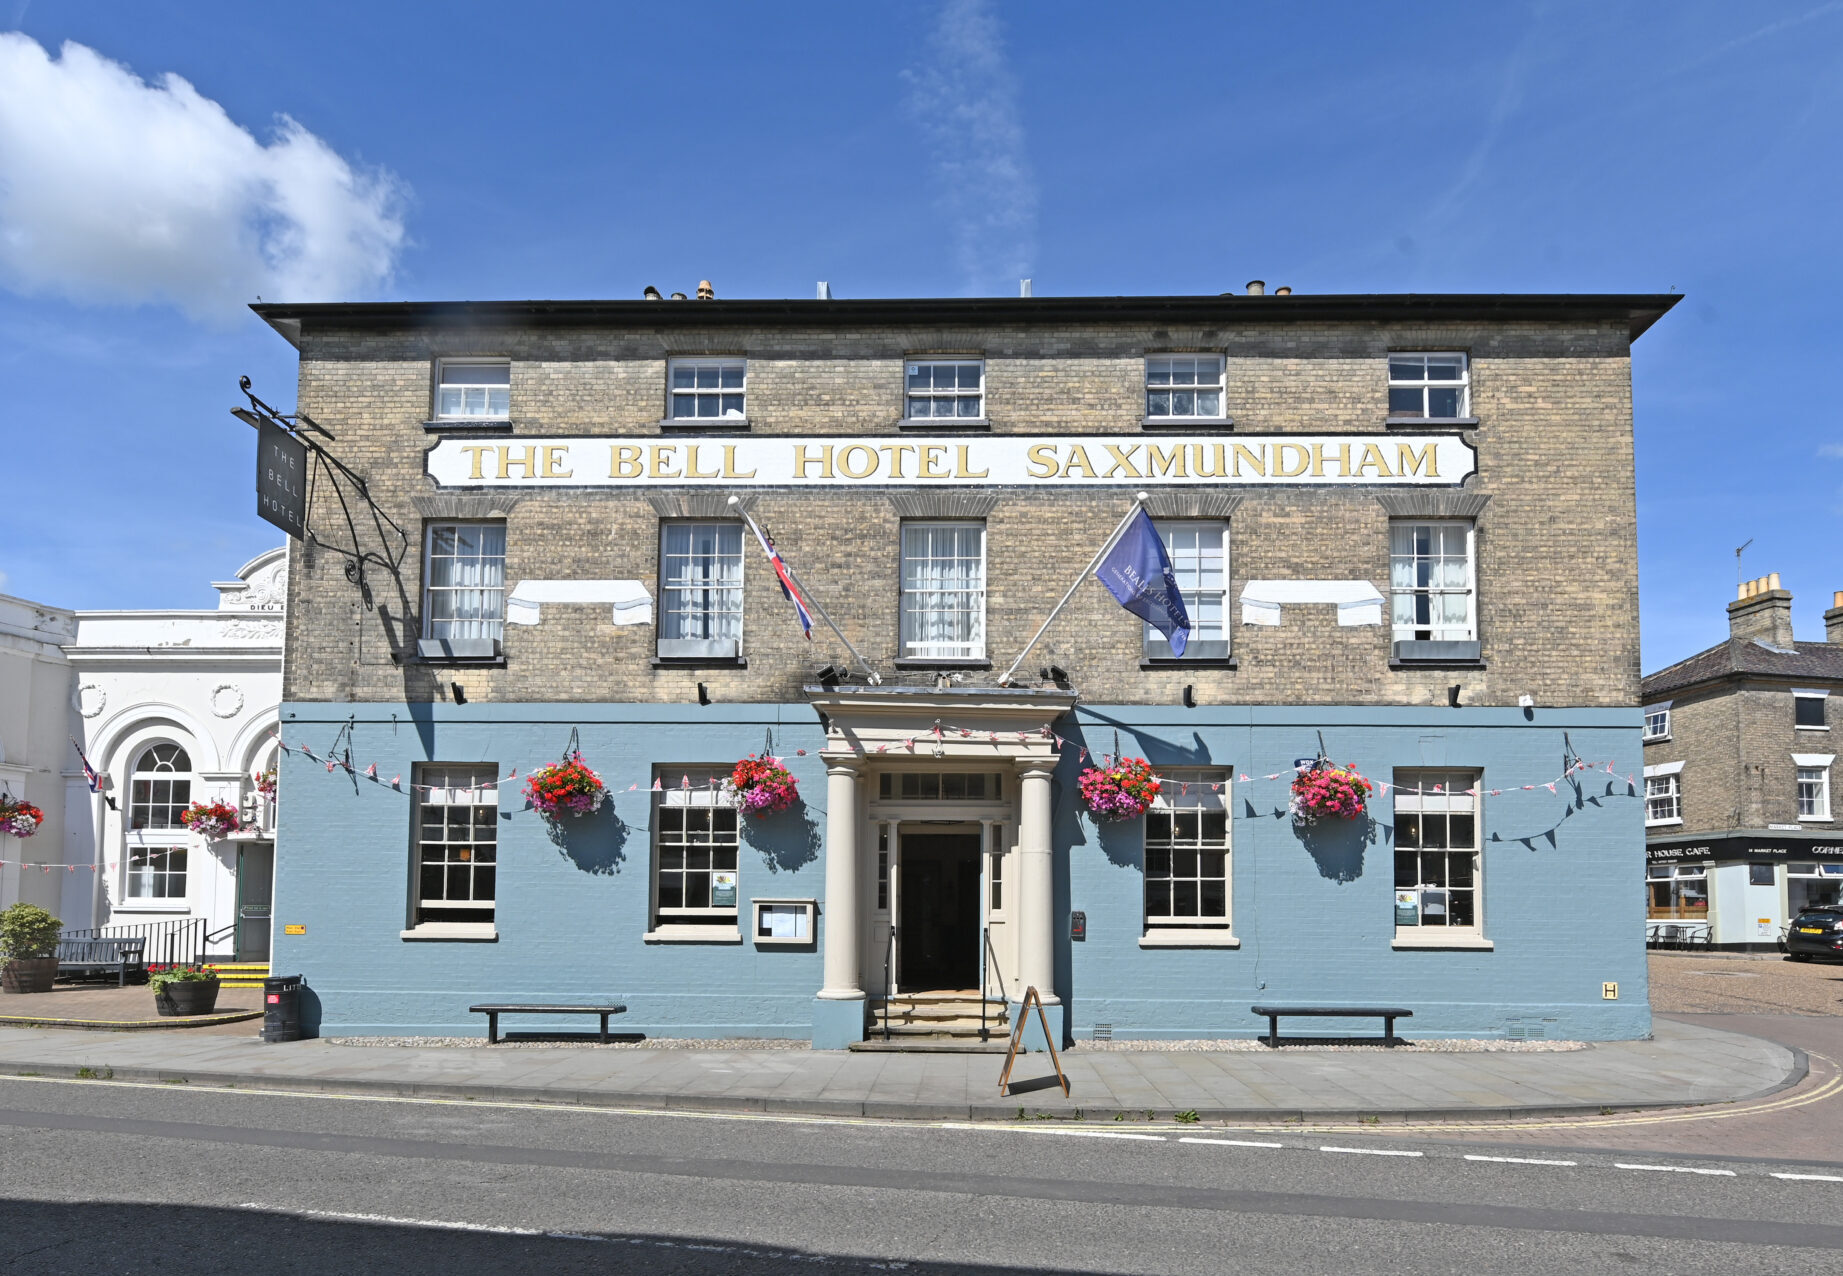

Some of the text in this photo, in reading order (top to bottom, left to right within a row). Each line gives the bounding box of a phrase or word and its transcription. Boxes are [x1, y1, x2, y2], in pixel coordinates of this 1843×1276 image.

[273, 445, 295, 470] THE
[460, 443, 1444, 479] THE BELL HOTEL SAXMUNDHAM
[268, 469, 298, 498] BELL
[263, 496, 302, 528] HOTEL
[1654, 848, 1684, 858] HOUSE
[1685, 846, 1711, 856] CAFE
[1604, 983, 1616, 998] H
